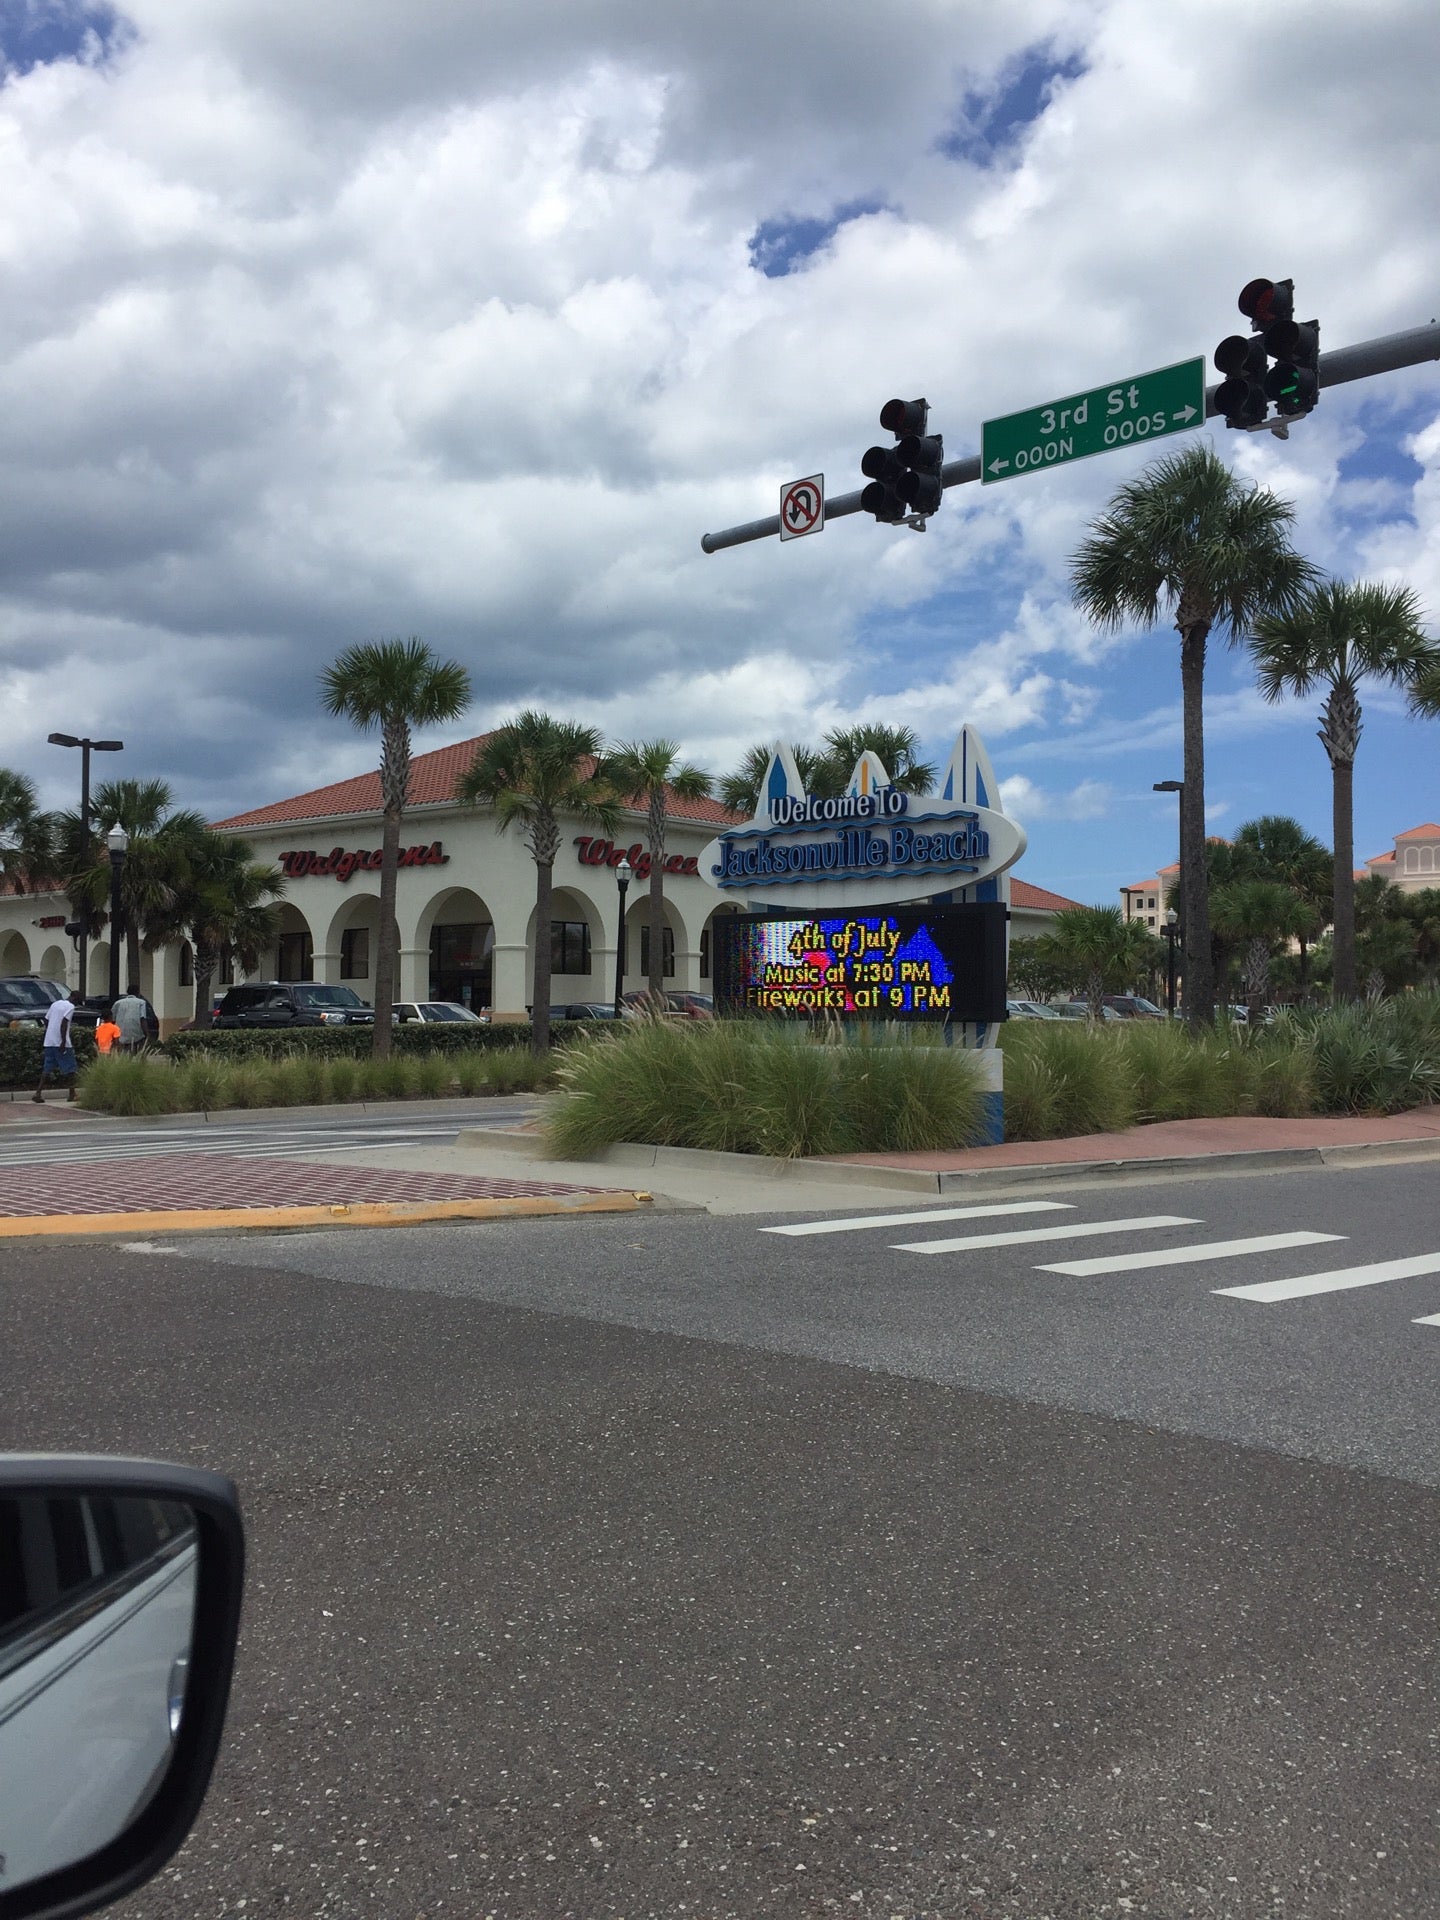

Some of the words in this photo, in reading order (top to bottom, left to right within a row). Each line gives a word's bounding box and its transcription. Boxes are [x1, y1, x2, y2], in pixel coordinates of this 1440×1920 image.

[1039, 398, 1088, 434] 3rd
[1107, 384, 1139, 415] St
[1015, 437, 1073, 469] 000N
[1103, 411, 1166, 444] 000S
[770, 794, 872, 825] Welcome
[875, 785, 904, 815] To
[278, 841, 450, 882] Walgrens
[711, 828, 889, 878] Jacksonville
[889, 821, 989, 865] Beach
[788, 920, 825, 959] 4th
[831, 922, 855, 958] of
[854, 920, 901, 958] July
[765, 963, 819, 983] Music
[826, 964, 846, 983] at
[853, 963, 893, 982] 7:30
[901, 962, 932, 982] PM
[746, 986, 845, 1008] Fireworks
[854, 986, 881, 1007] at
[889, 987, 903, 1007] 9
[913, 985, 951, 1007] PM
